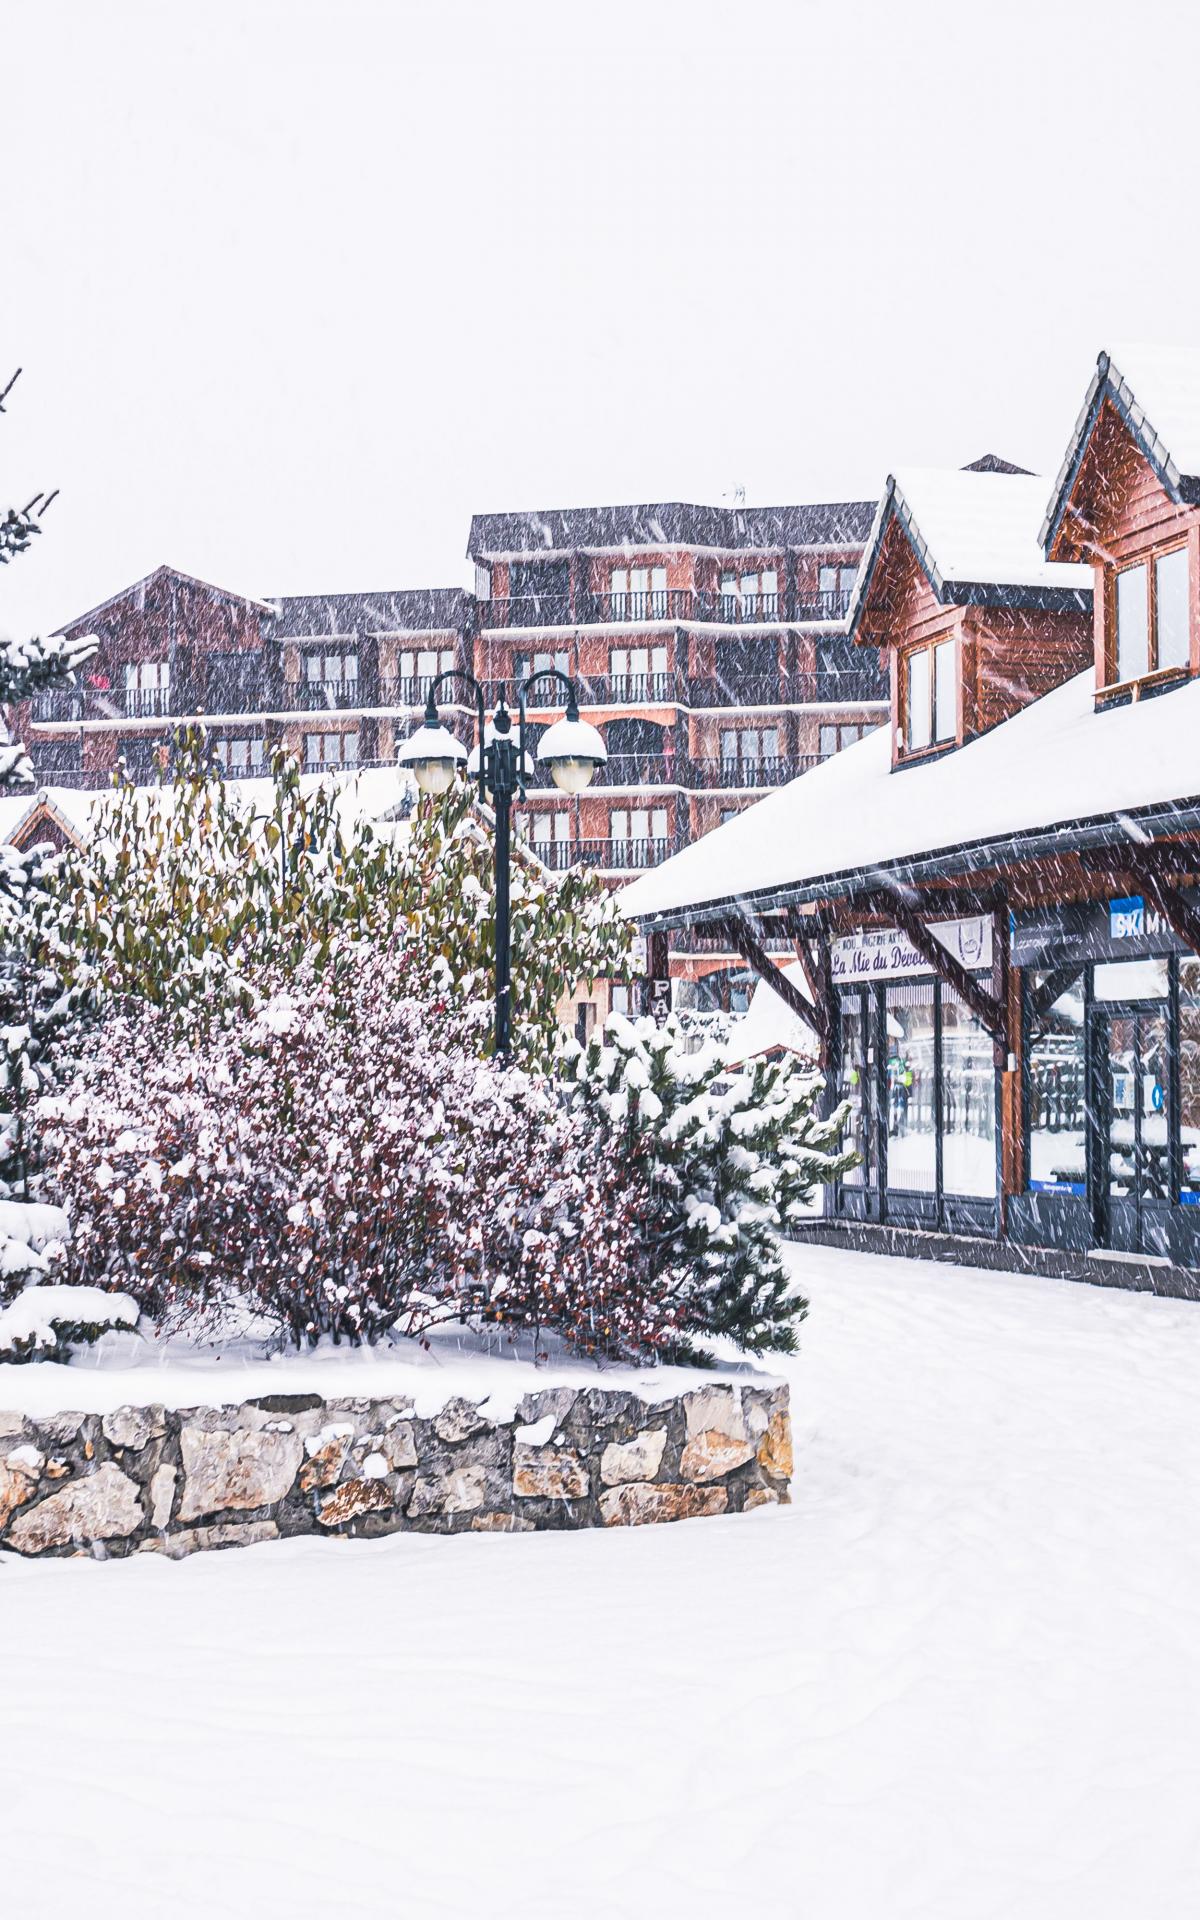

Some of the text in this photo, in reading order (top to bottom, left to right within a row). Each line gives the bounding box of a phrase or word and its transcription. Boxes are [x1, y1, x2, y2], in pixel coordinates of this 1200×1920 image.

[832, 953, 846, 976] La
[849, 950, 870, 973] Mie
[873, 949, 888, 971] du
